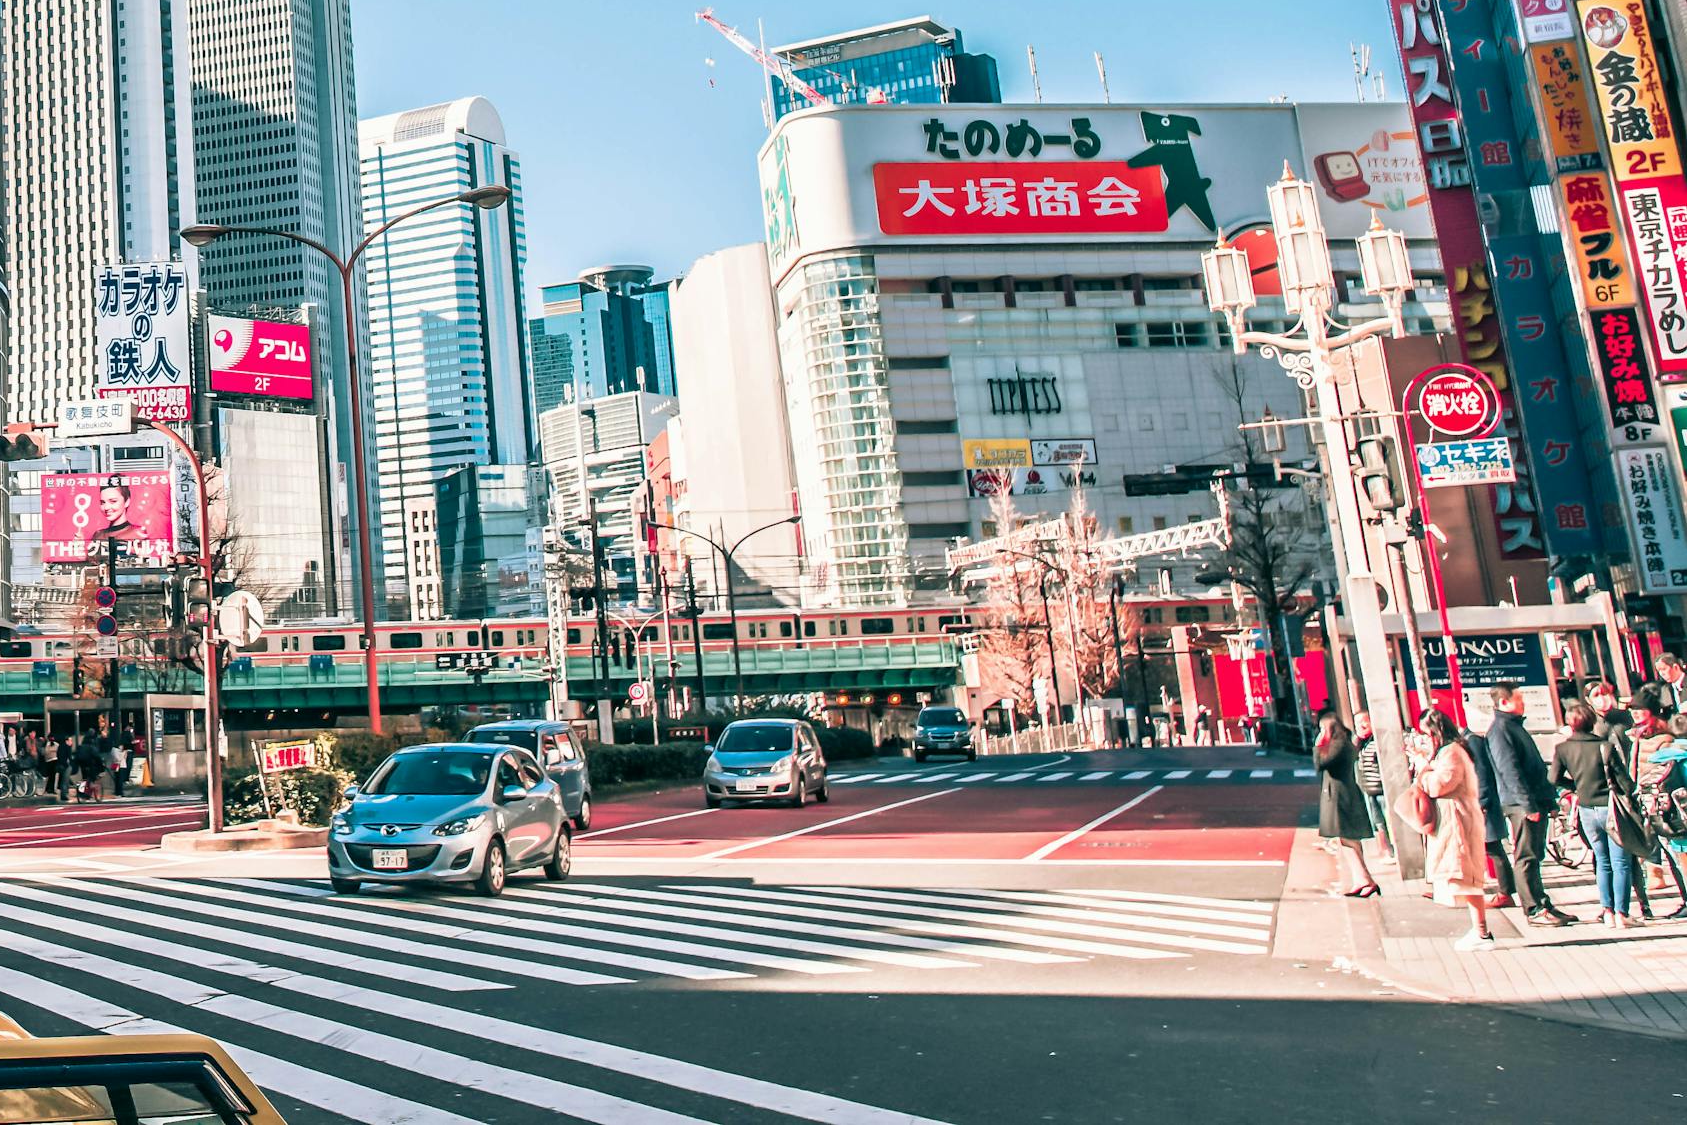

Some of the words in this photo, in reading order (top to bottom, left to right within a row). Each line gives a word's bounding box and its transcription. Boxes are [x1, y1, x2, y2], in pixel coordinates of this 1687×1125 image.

[1594, 50, 1655, 144] 金の蔵
[922, 118, 1103, 160] たのめーる
[1625, 149, 1666, 174] 2F
[898, 177, 1142, 219] 大塚商会
[1629, 193, 1687, 355] 東京チカラめし
[99, 265, 185, 316] カラオケ
[1595, 284, 1620, 302] 6F
[132, 312, 152, 339] の
[1454, 262, 1508, 393] パチンコ
[107, 338, 180, 384] 鉄人
[257, 337, 307, 362] アコム
[1600, 312, 1648, 404] お好み焼
[254, 376, 271, 391] 2F
[1505, 255, 1587, 531] カラオケ館
[65, 403, 124, 420] 歌舞伎町
[1426, 392, 1482, 417] 消火栓
[1615, 404, 1654, 421] 本陣
[76, 422, 112, 430] Kabukicho
[1625, 425, 1652, 442] 8F
[45, 476, 169, 488] 世界の不動産を面白くする
[1629, 464, 1665, 573] お好み焼き本陣
